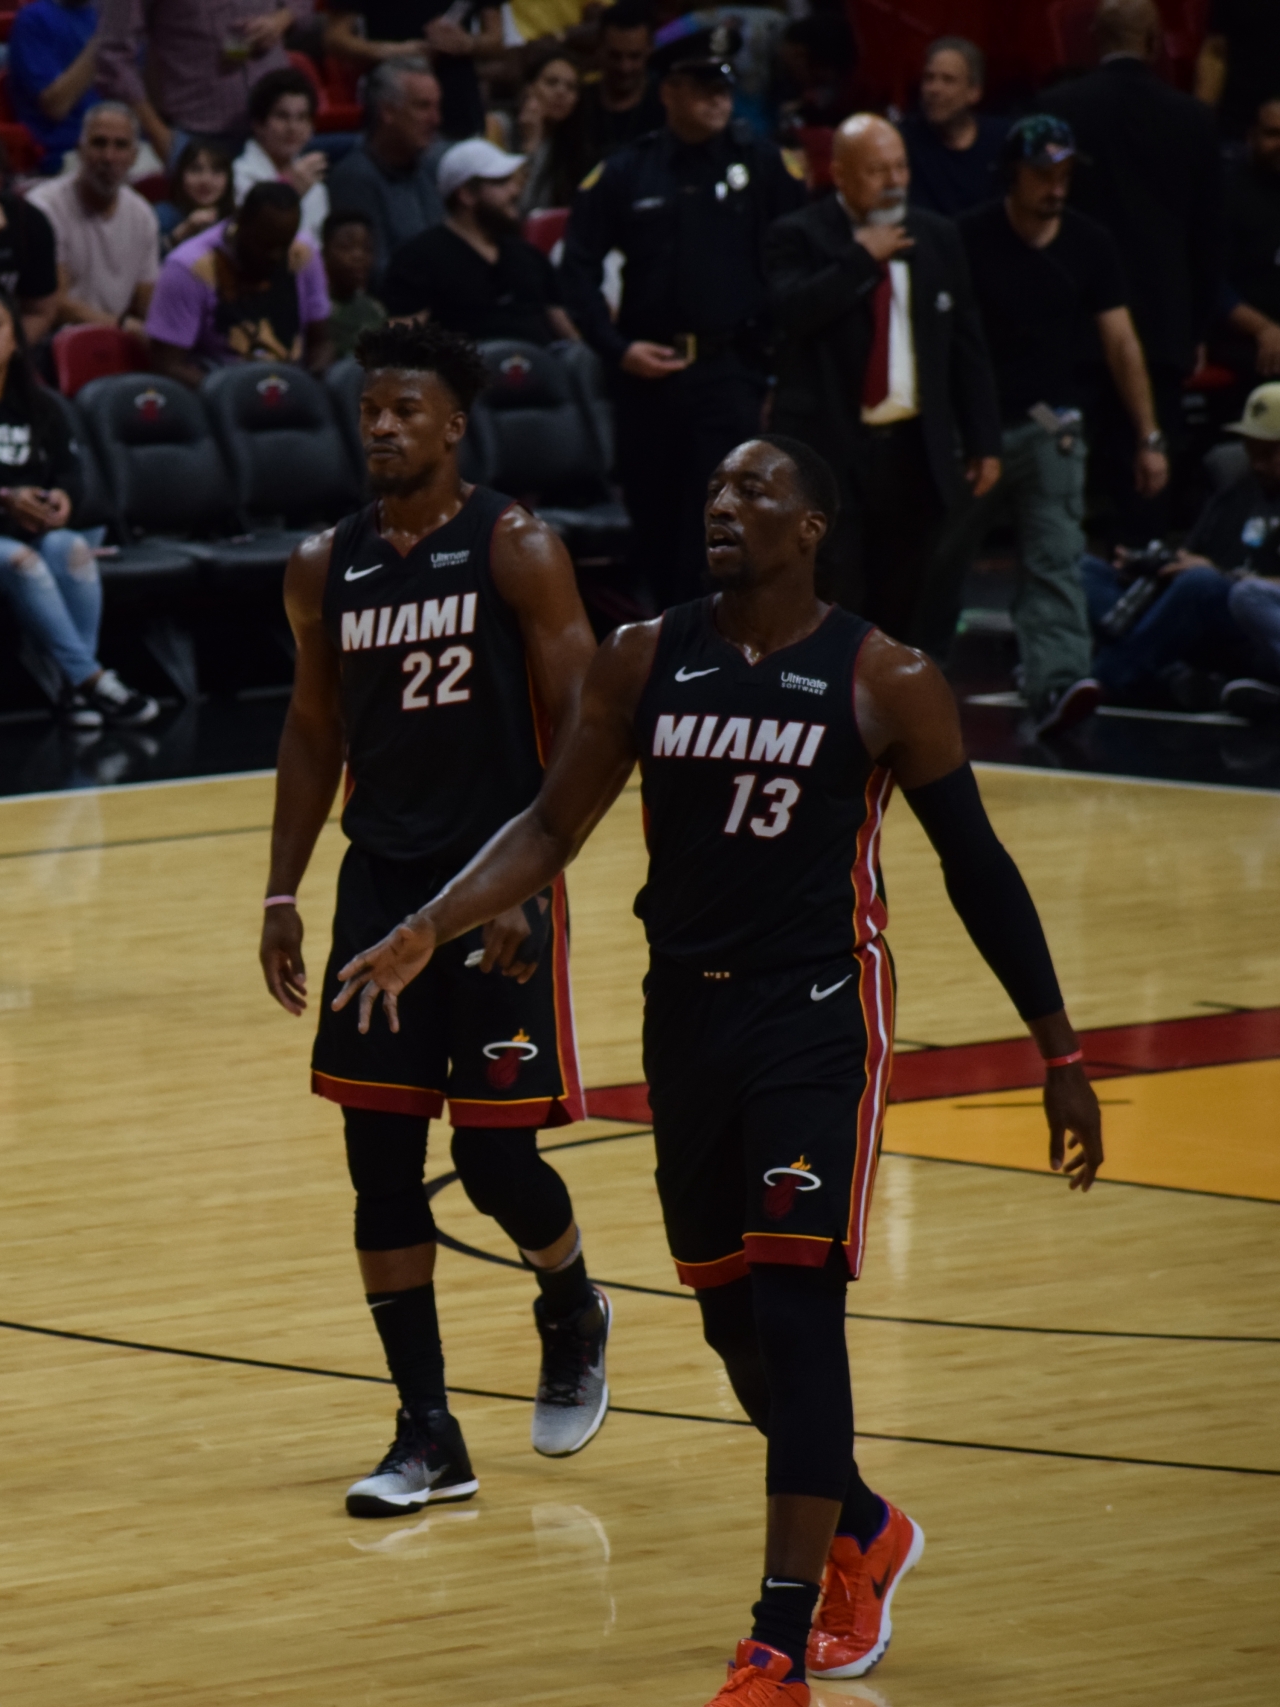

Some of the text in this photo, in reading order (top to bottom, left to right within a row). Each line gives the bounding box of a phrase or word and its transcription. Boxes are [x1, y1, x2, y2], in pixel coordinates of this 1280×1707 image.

[341, 592, 477, 651] MIAMI
[402, 645, 472, 710] 22
[780, 671, 828, 690] Ultimate
[652, 714, 826, 767] MIAMI
[724, 774, 801, 838] 13
